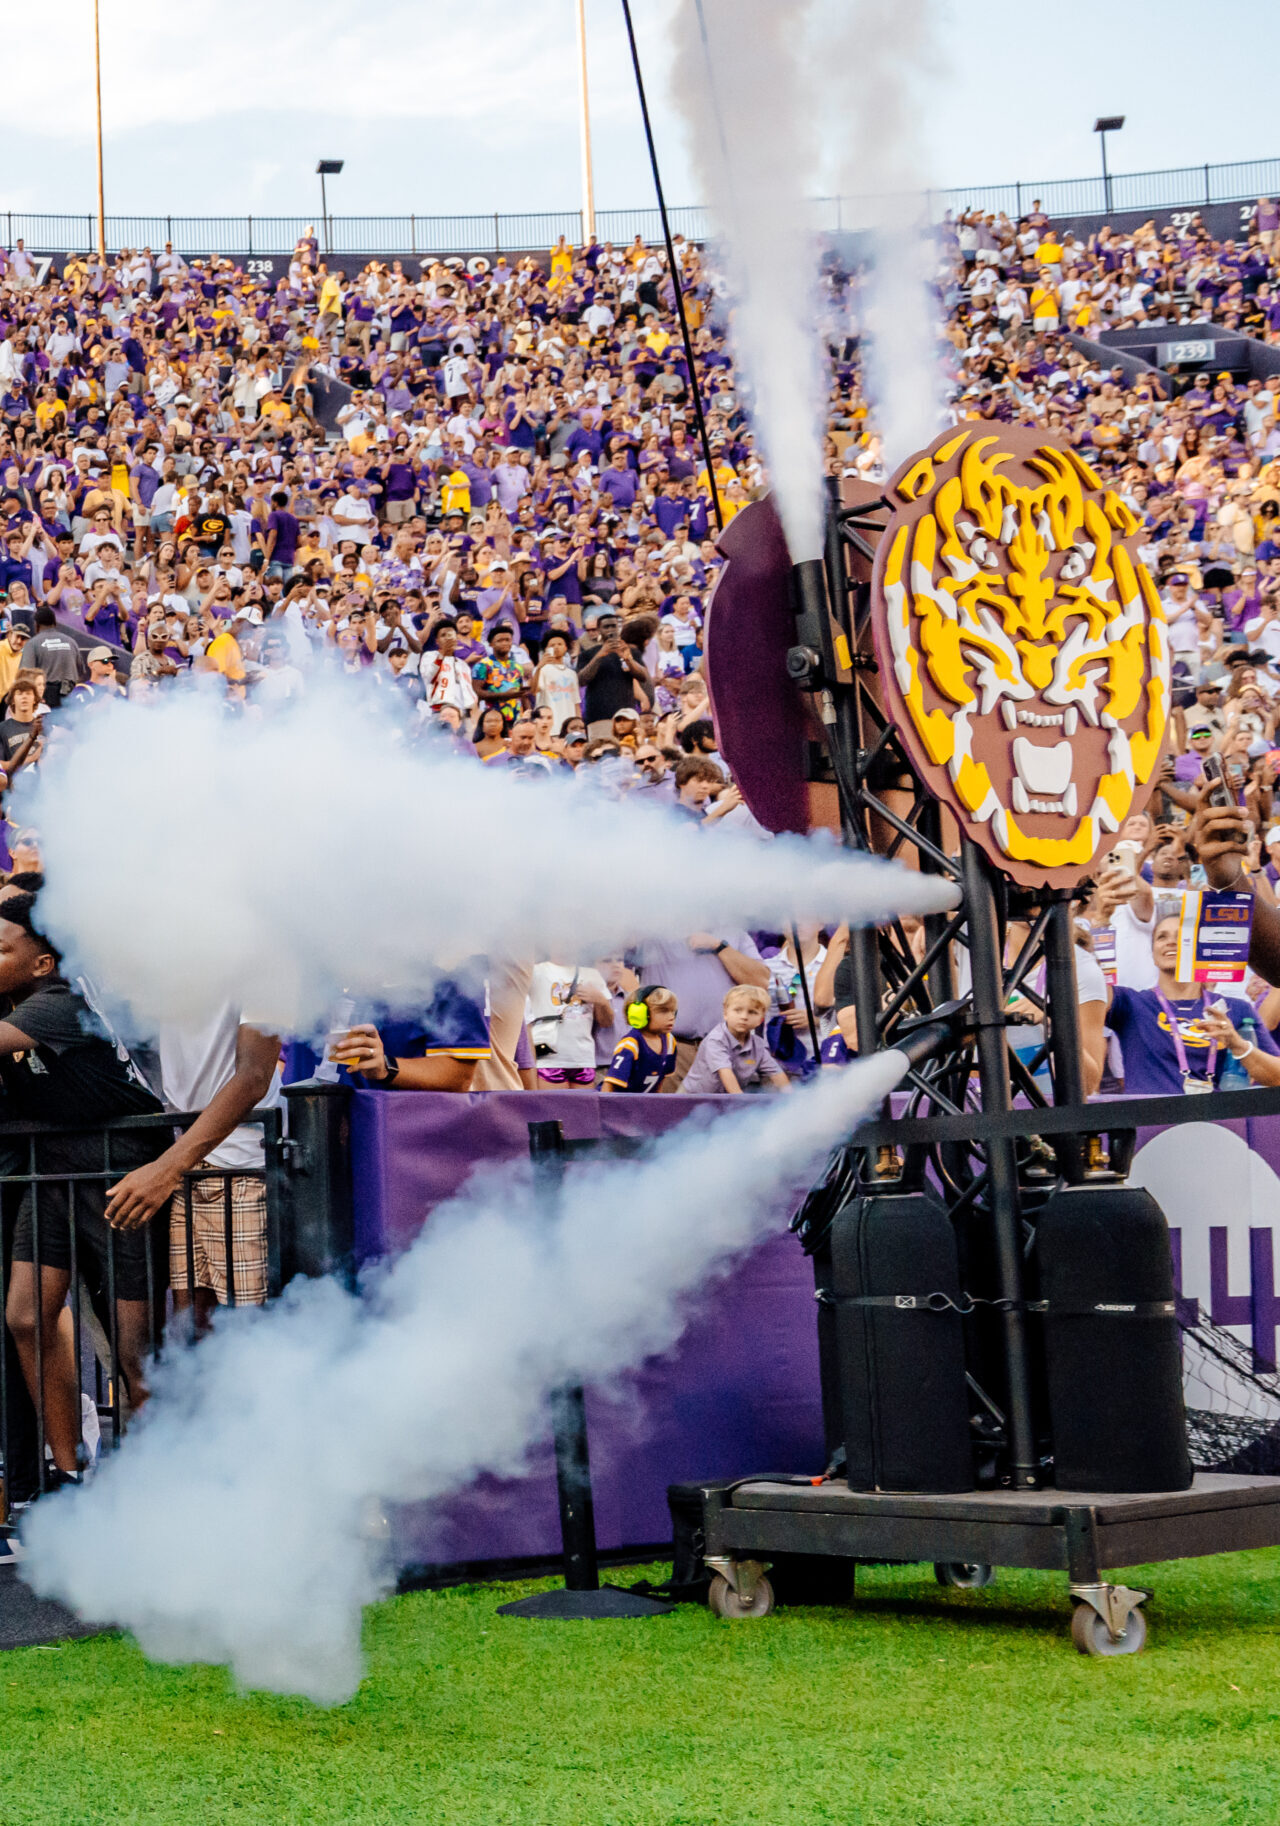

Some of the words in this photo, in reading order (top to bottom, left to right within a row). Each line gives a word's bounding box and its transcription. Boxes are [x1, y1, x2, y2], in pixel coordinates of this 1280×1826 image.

[247, 260, 272, 272] 238
[1175, 343, 1207, 362] 239
[689, 503, 700, 520] 7
[1205, 908, 1249, 922] LSU
[829, 1041, 839, 1057] 5
[614, 1055, 624, 1069] 7
[642, 1075, 660, 1094] 7
[1104, 1304, 1136, 1312] HUSKY
